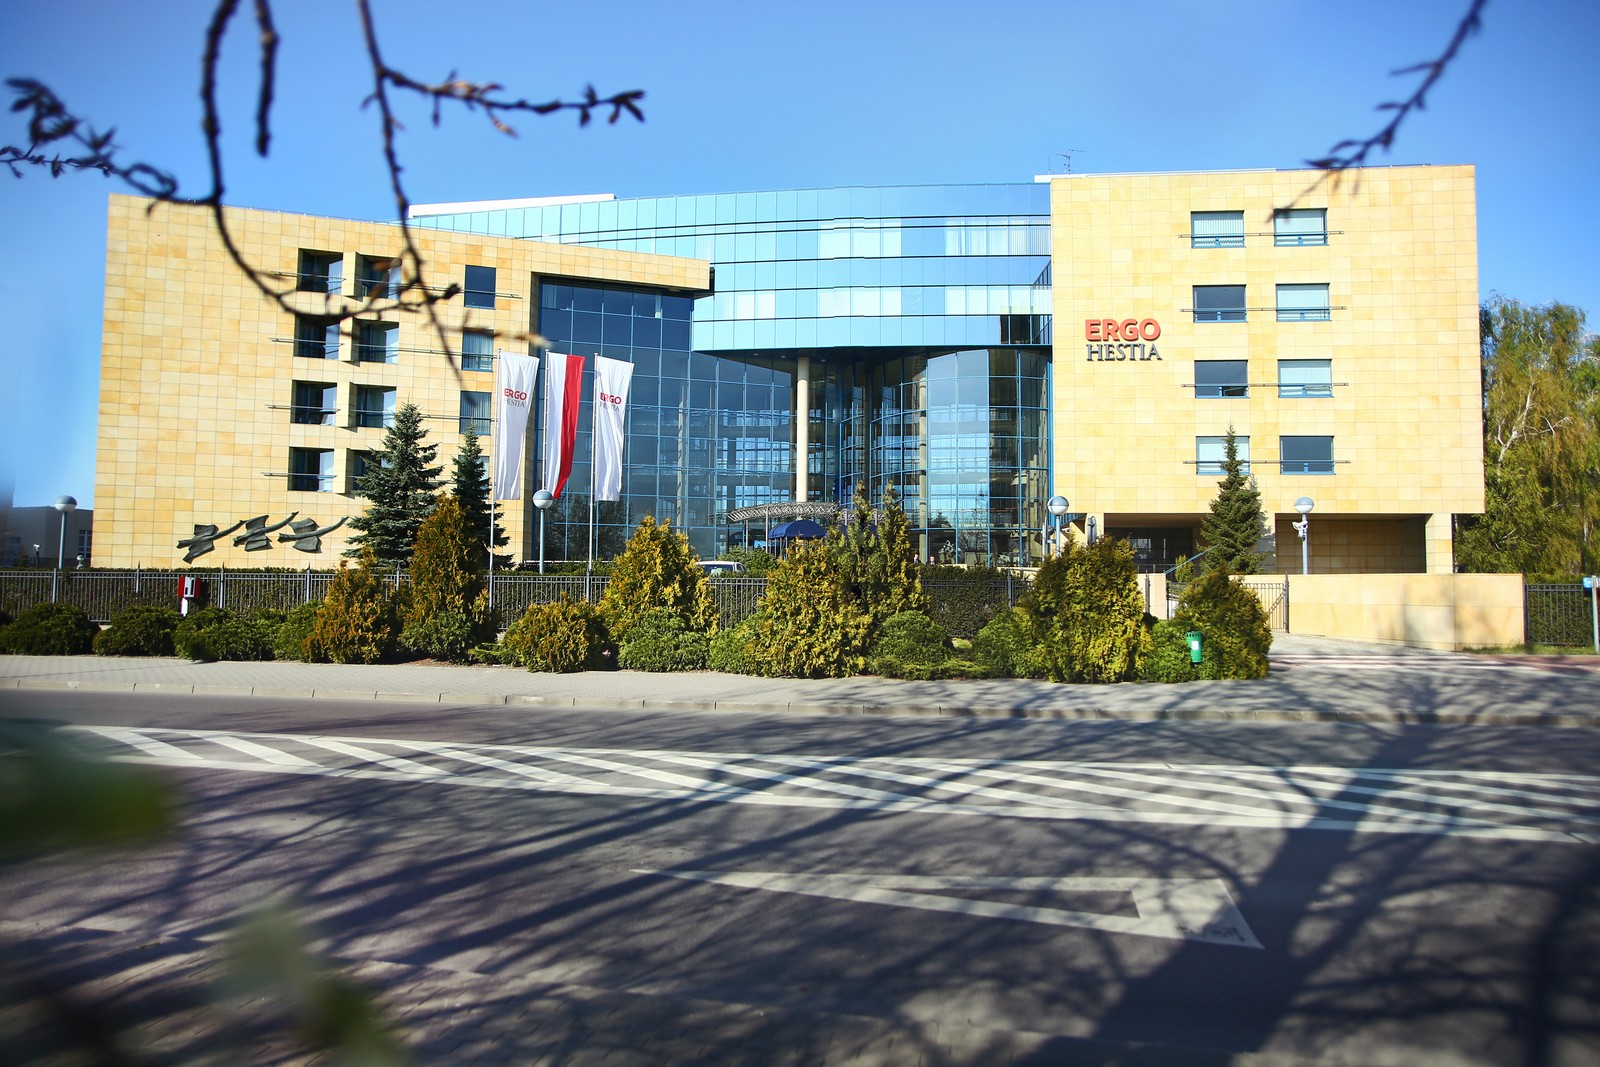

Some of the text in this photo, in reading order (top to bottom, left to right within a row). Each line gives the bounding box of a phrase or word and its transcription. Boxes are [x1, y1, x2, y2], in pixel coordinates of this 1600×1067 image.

[1085, 318, 1161, 342] ERGO
[1086, 343, 1163, 361] HESTIA
[504, 388, 527, 401] ERGO
[600, 392, 622, 405] ERGO
